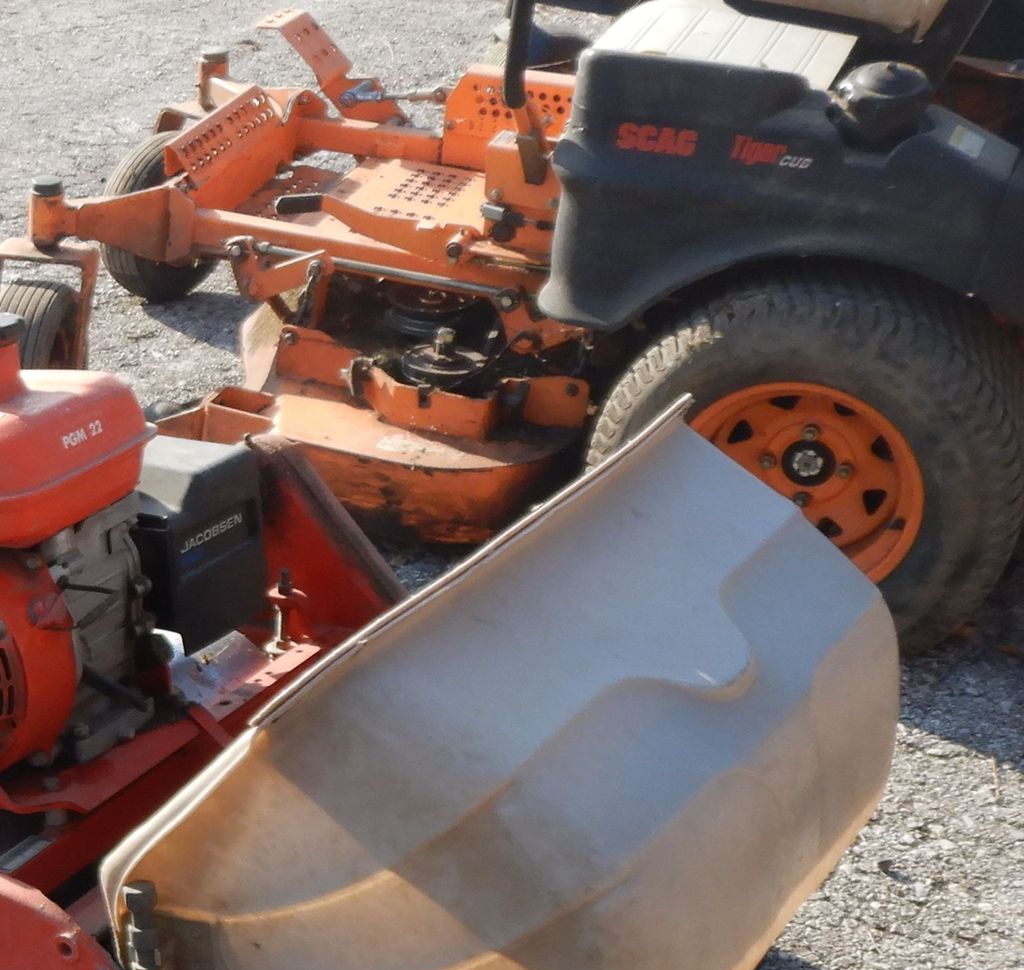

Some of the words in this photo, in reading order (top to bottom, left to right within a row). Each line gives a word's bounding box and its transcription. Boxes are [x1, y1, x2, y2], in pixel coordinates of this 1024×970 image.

[616, 122, 698, 157] SCAG
[62, 428, 88, 449] PGM
[88, 420, 103, 436] 22
[180, 512, 243, 554] JACOBSEN
